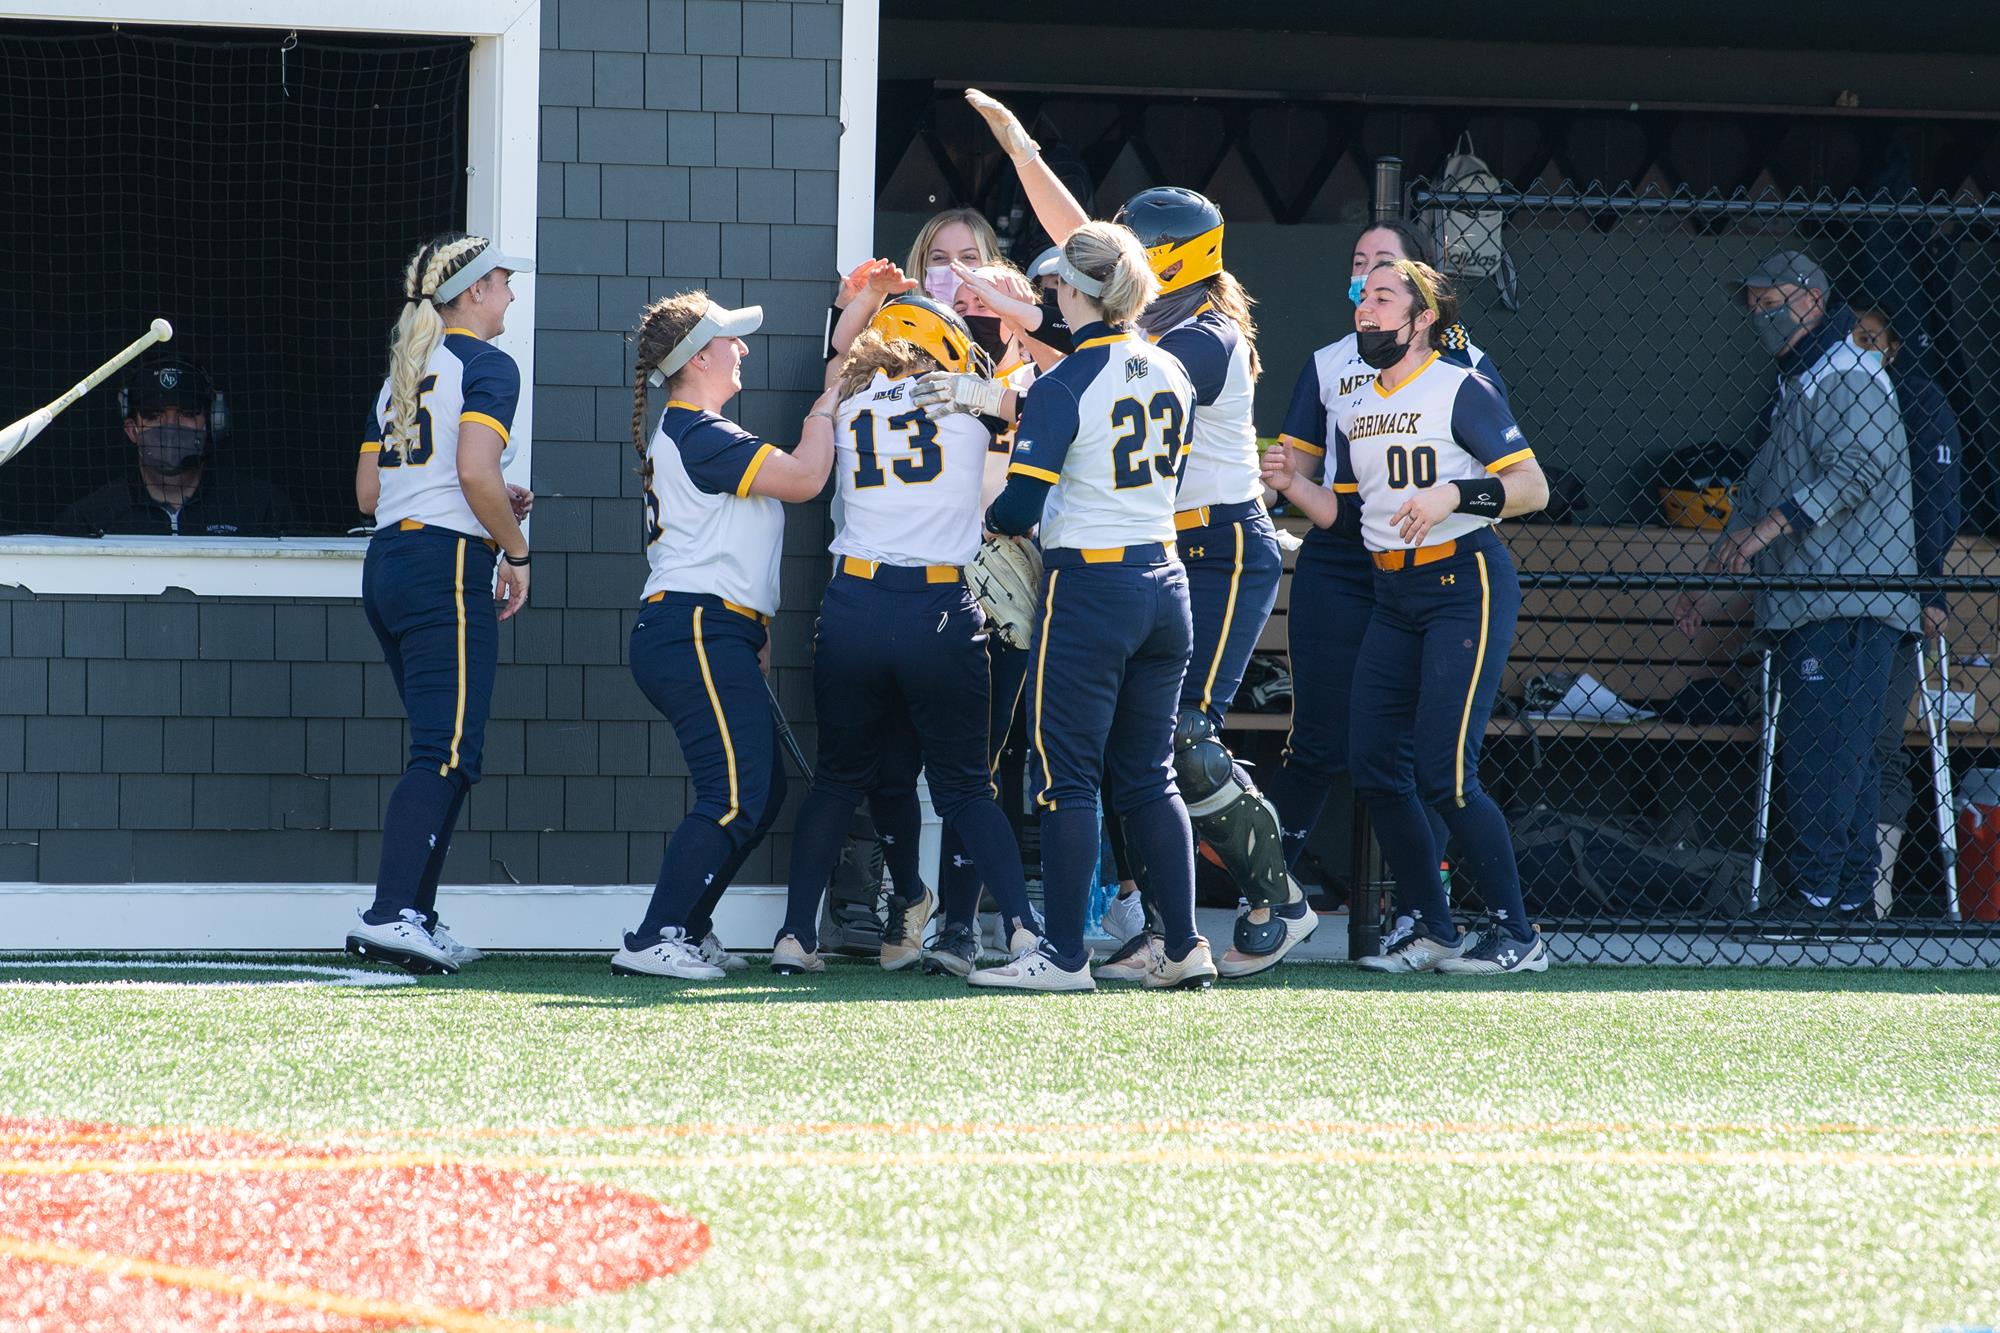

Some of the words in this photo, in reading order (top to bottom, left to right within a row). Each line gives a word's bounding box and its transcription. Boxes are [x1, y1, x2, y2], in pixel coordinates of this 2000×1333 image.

[1125, 354, 1148, 383] MC
[848, 407, 944, 490] 13
[1110, 390, 1184, 490] 23
[1936, 445, 1951, 464] 11
[1386, 445, 1438, 489] 00
